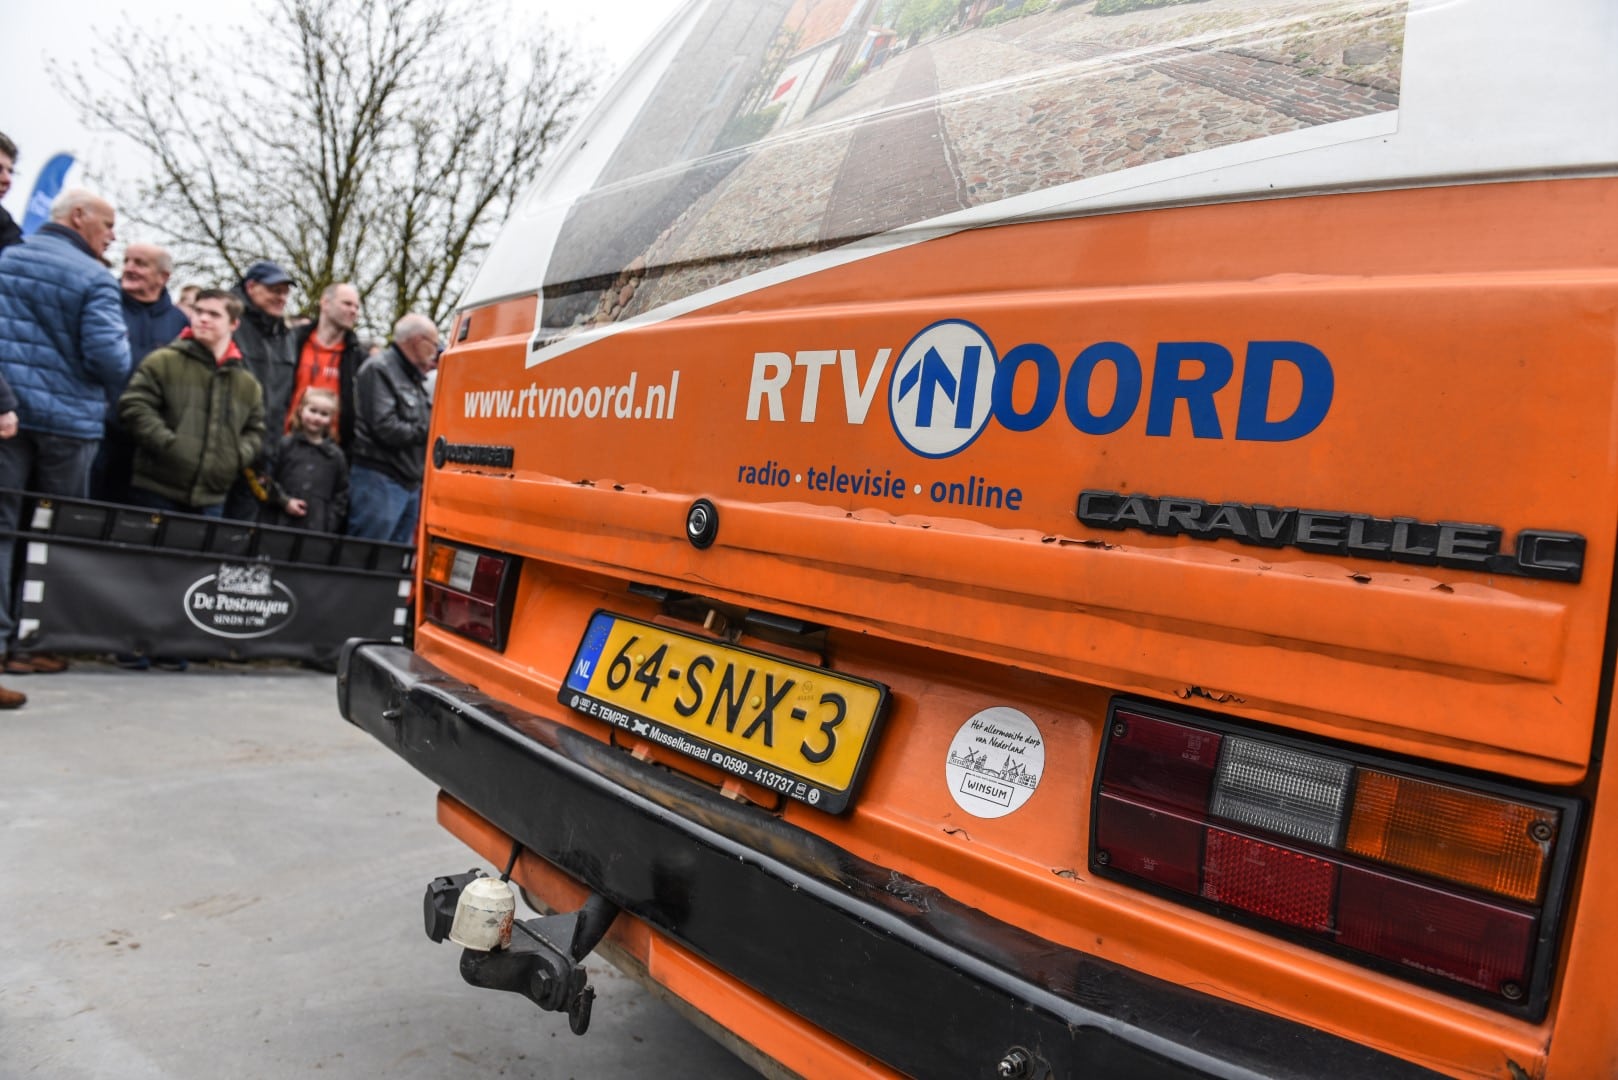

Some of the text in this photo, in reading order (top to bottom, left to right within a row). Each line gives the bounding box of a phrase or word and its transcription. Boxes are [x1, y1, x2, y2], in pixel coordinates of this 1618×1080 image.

[464, 370, 680, 420] www.rtvnoord.nl
[745, 347, 892, 426] RTV
[738, 460, 1023, 512] radio televisie online
[1078, 489, 1587, 583] CARAVELLE C
[575, 658, 590, 678] NL
[606, 636, 847, 763] 64-SNX-3
[598, 705, 630, 729] TEMPEL
[649, 726, 711, 760] Musselkanaal
[722, 755, 748, 775] 0599
[754, 768, 794, 793] 413737
[971, 719, 1041, 748] Het allermooiste dorp
[975, 736, 1026, 755] van Nederland
[967, 780, 1008, 800] WINSUM
